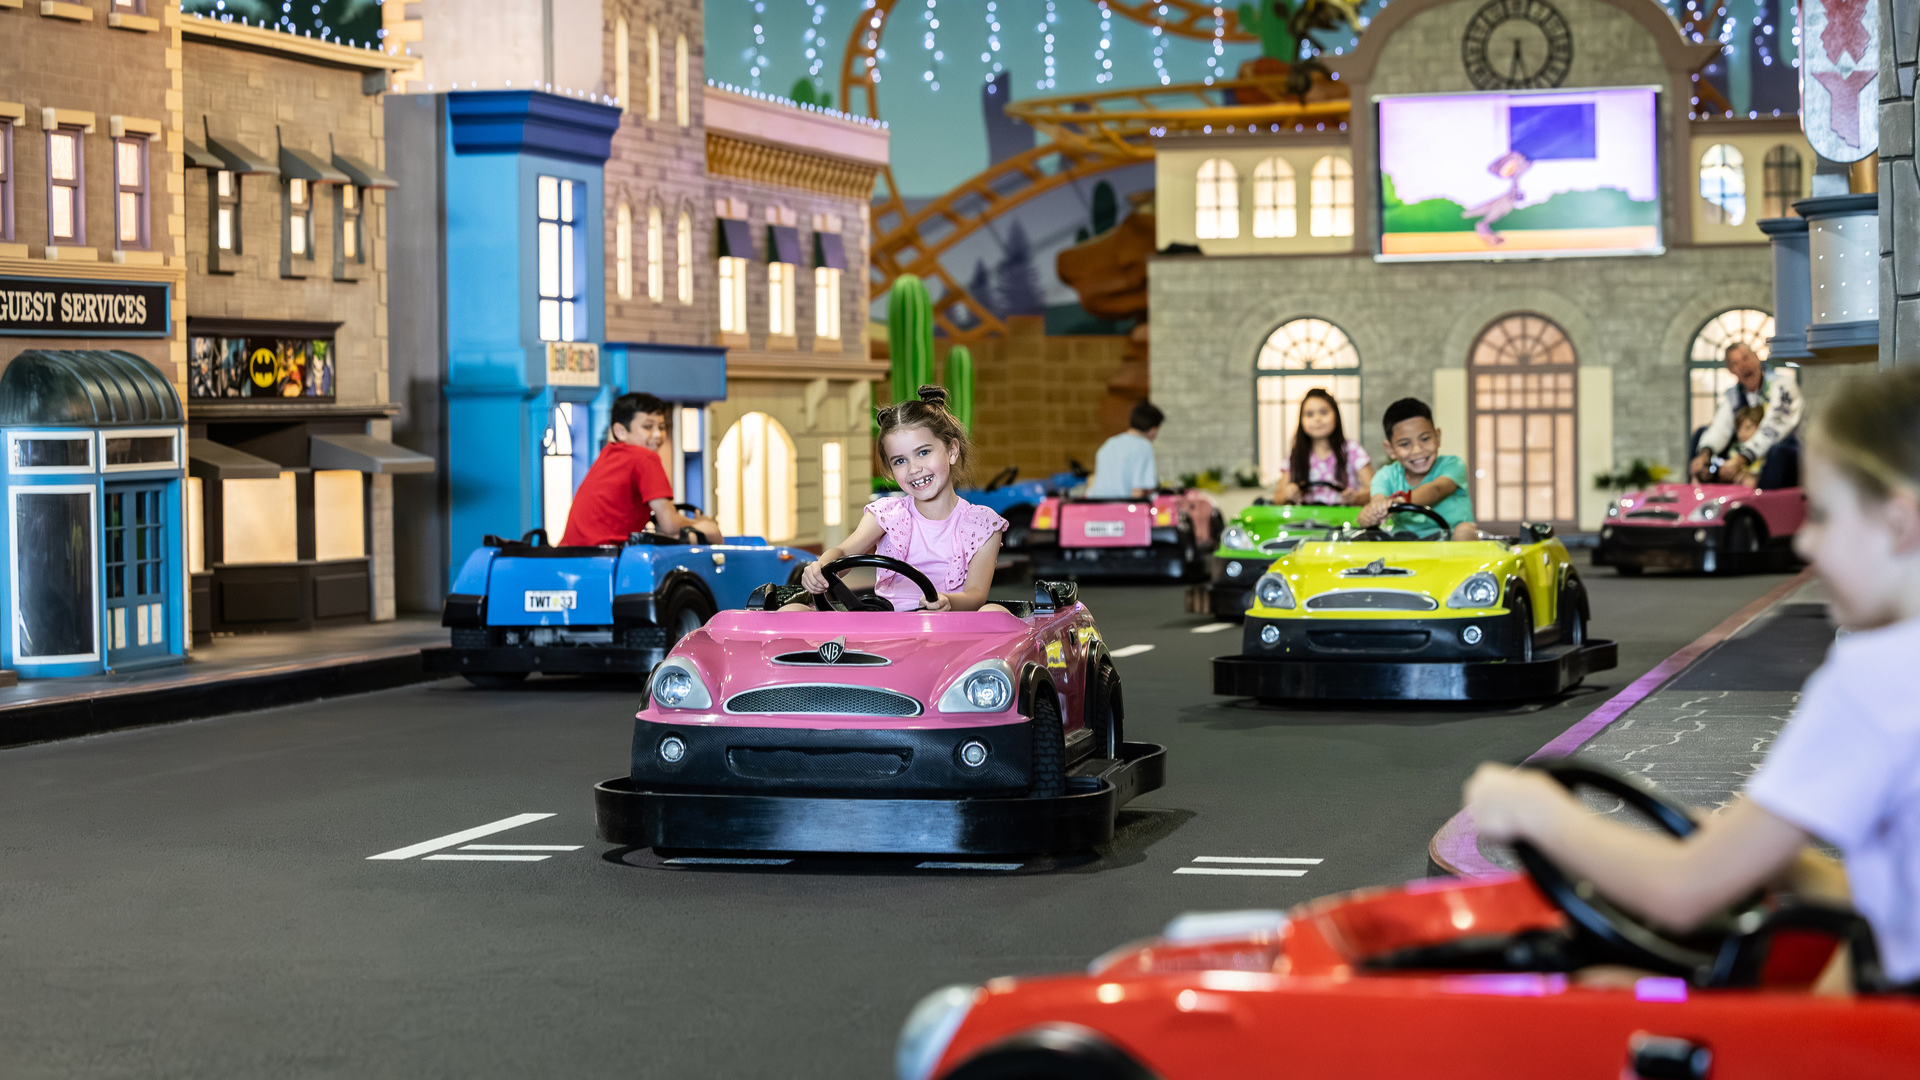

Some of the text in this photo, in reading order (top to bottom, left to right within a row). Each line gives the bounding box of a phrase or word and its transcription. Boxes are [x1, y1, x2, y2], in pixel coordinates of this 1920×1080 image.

[0, 290, 147, 324] GUEST SERVICES
[530, 596, 550, 608] TWT
[820, 643, 839, 661] WB
